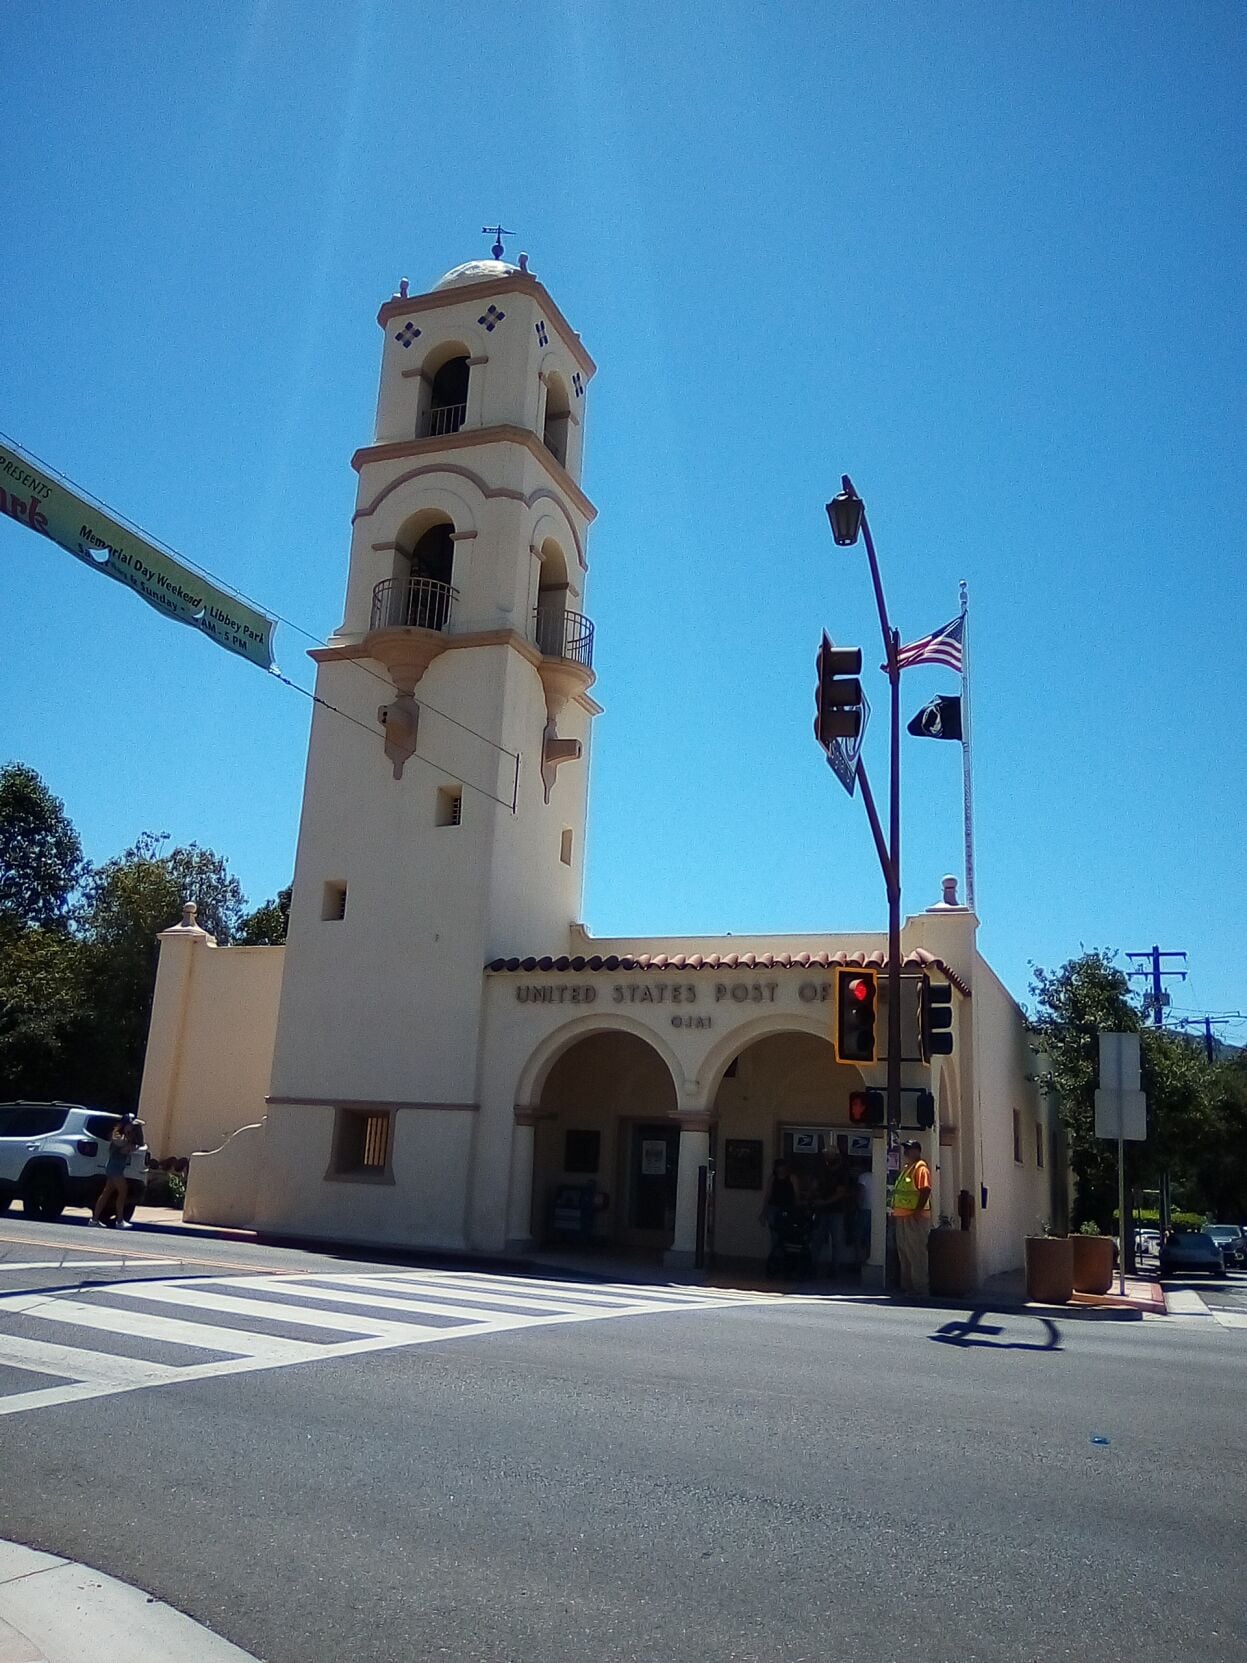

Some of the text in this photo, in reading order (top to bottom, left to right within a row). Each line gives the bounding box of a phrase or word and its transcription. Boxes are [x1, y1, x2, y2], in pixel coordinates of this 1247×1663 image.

[79, 525, 133, 566] Memorial
[134, 560, 155, 581] Day
[157, 573, 202, 608] Weekend
[209, 606, 241, 632] Libbey
[243, 625, 265, 645] Park
[140, 582, 178, 611] Sunday
[232, 635, 248, 651] PM
[516, 984, 597, 1003] UNITED
[613, 984, 696, 1003] STATES
[714, 983, 779, 1003] POST
[671, 1015, 712, 1029] OJAI
